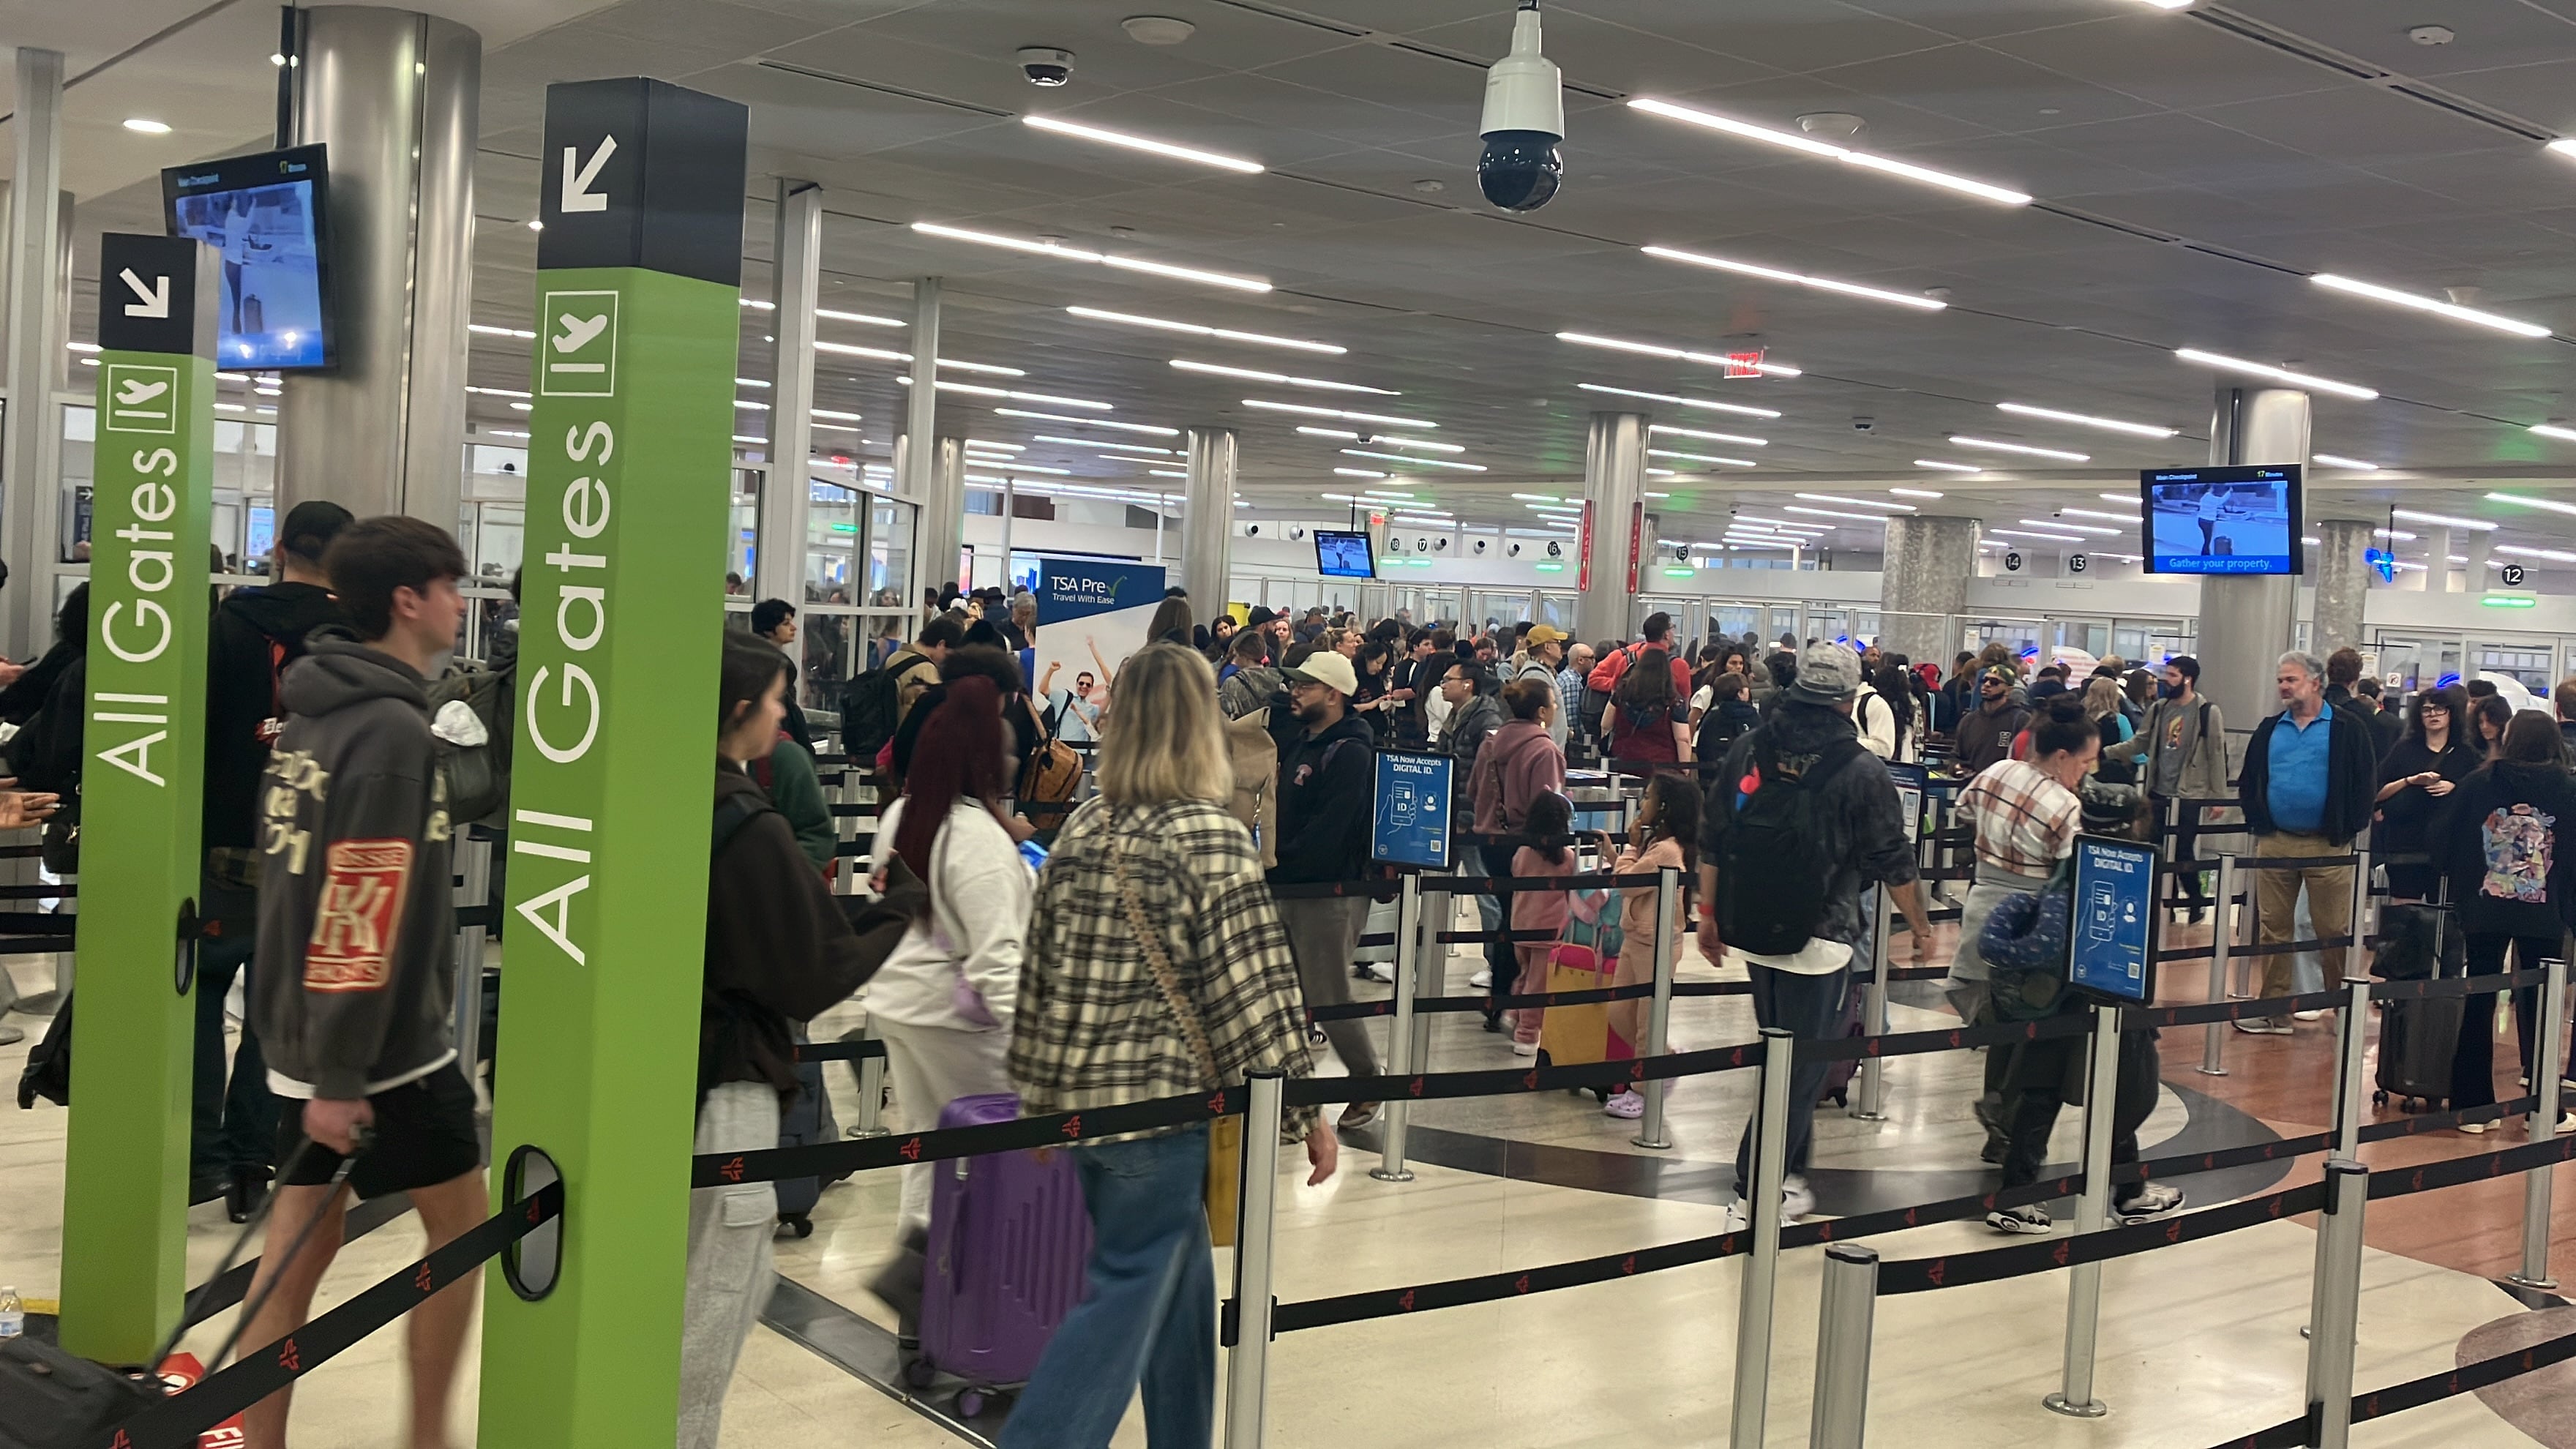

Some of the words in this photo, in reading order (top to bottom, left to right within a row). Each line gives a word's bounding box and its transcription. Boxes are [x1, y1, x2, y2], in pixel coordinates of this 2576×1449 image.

[1418, 540, 1426, 550] 17
[1549, 544, 1558, 554] 16
[102, 448, 177, 662] Gates
[1679, 548, 1688, 558] 15
[2007, 557, 2019, 568] 14
[2071, 558, 2085, 569] 13
[2169, 558, 2200, 568] Gather
[2203, 560, 2225, 570] your
[2227, 559, 2272, 570] property.
[2505, 568, 2522, 582] 12
[1051, 576, 1079, 591] TSA
[1082, 578, 1106, 593] Pre
[526, 420, 614, 763] Gates
[1052, 593, 1076, 602] Travel
[1077, 595, 1096, 604] With
[1097, 596, 1115, 604] Ease
[93, 692, 168, 787] All
[1386, 755, 1399, 763] TSA
[1400, 756, 1415, 764] Now
[1416, 757, 1442, 766] Accepts
[1393, 764, 1421, 774] DIGITAL
[1397, 803, 1407, 812] ID
[514, 809, 593, 967] All
